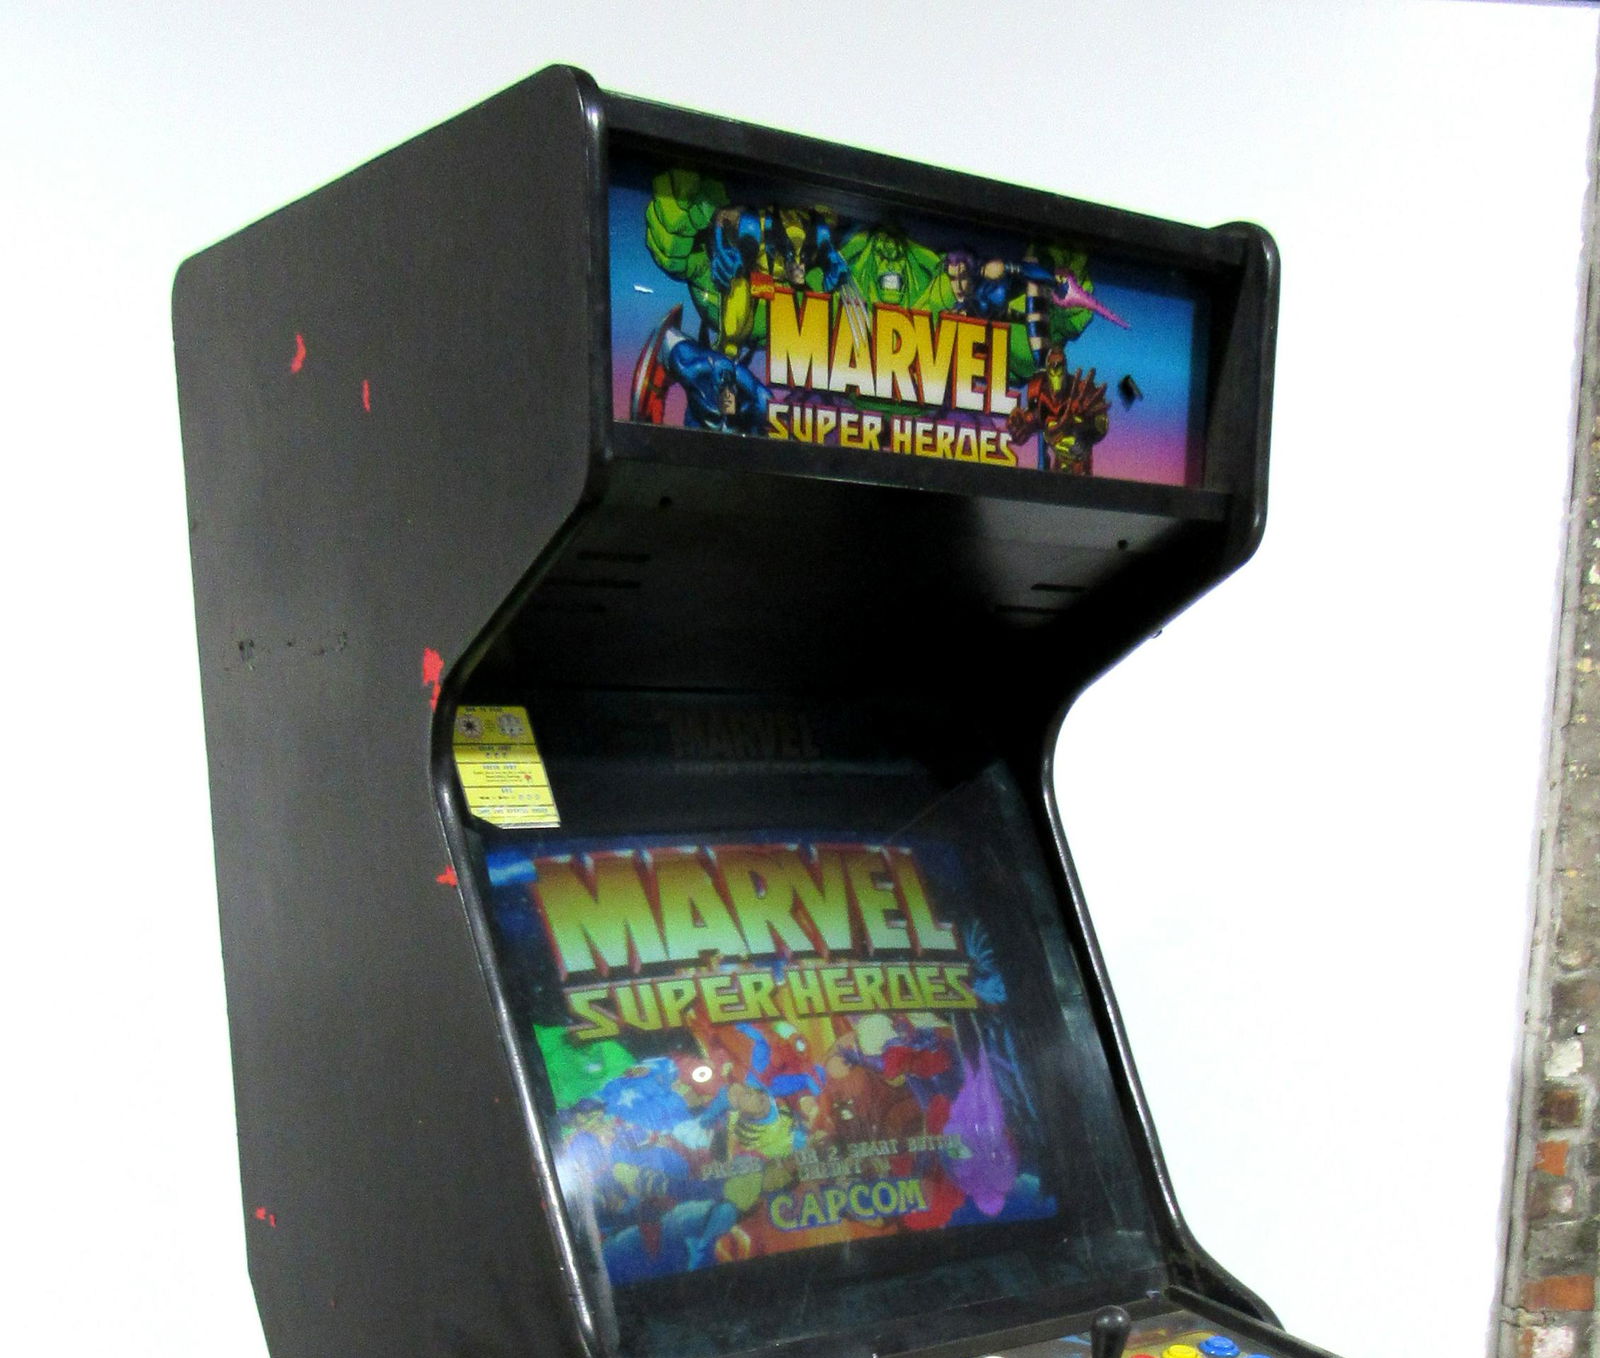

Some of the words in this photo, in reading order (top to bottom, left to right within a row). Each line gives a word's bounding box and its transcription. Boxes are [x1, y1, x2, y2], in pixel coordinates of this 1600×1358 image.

[767, 291, 1018, 416] MARVEL
[768, 402, 882, 453] SUPER
[891, 422, 1019, 469] HEROES
[533, 845, 960, 981] MARVEL
[566, 970, 779, 1042] SUPER
[785, 959, 979, 1018] HEROES
[769, 1178, 928, 1231] CAPCOM
